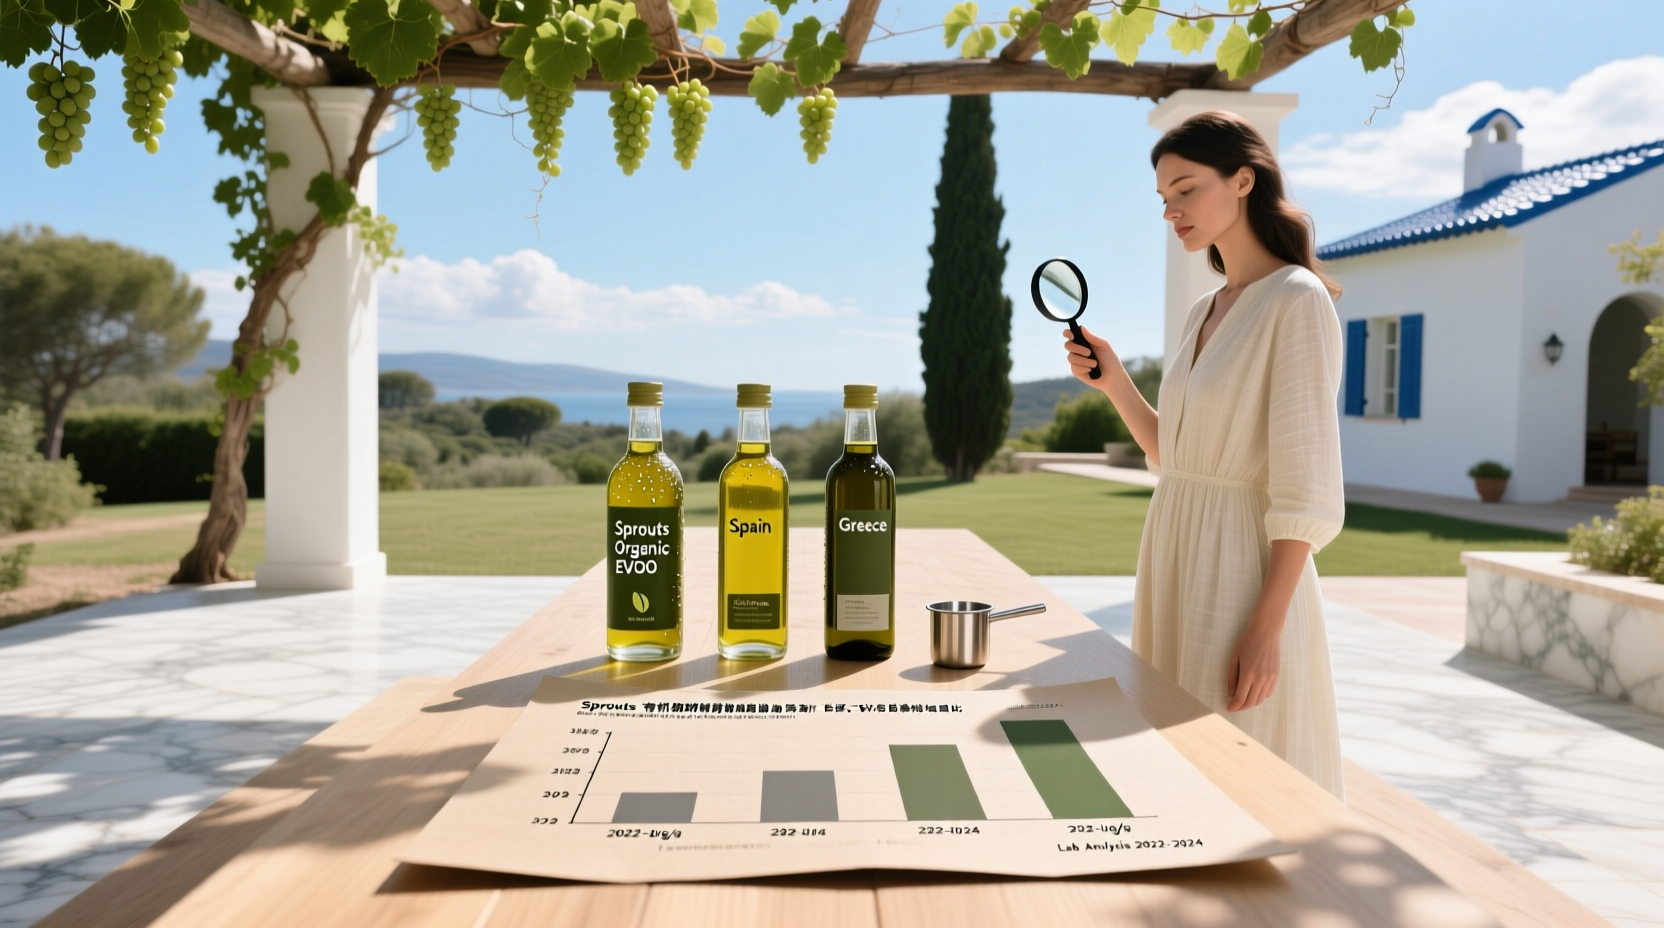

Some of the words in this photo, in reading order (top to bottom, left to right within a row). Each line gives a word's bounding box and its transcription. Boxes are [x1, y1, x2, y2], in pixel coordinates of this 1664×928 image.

[615, 520, 670, 540] Sprouts
[729, 518, 772, 538] Spain
[839, 517, 888, 532] Greece
[615, 540, 670, 559] Organic
[615, 559, 658, 574] EVOO
[580, 701, 637, 712] Sprouts
[1057, 843, 1079, 851] Lab
